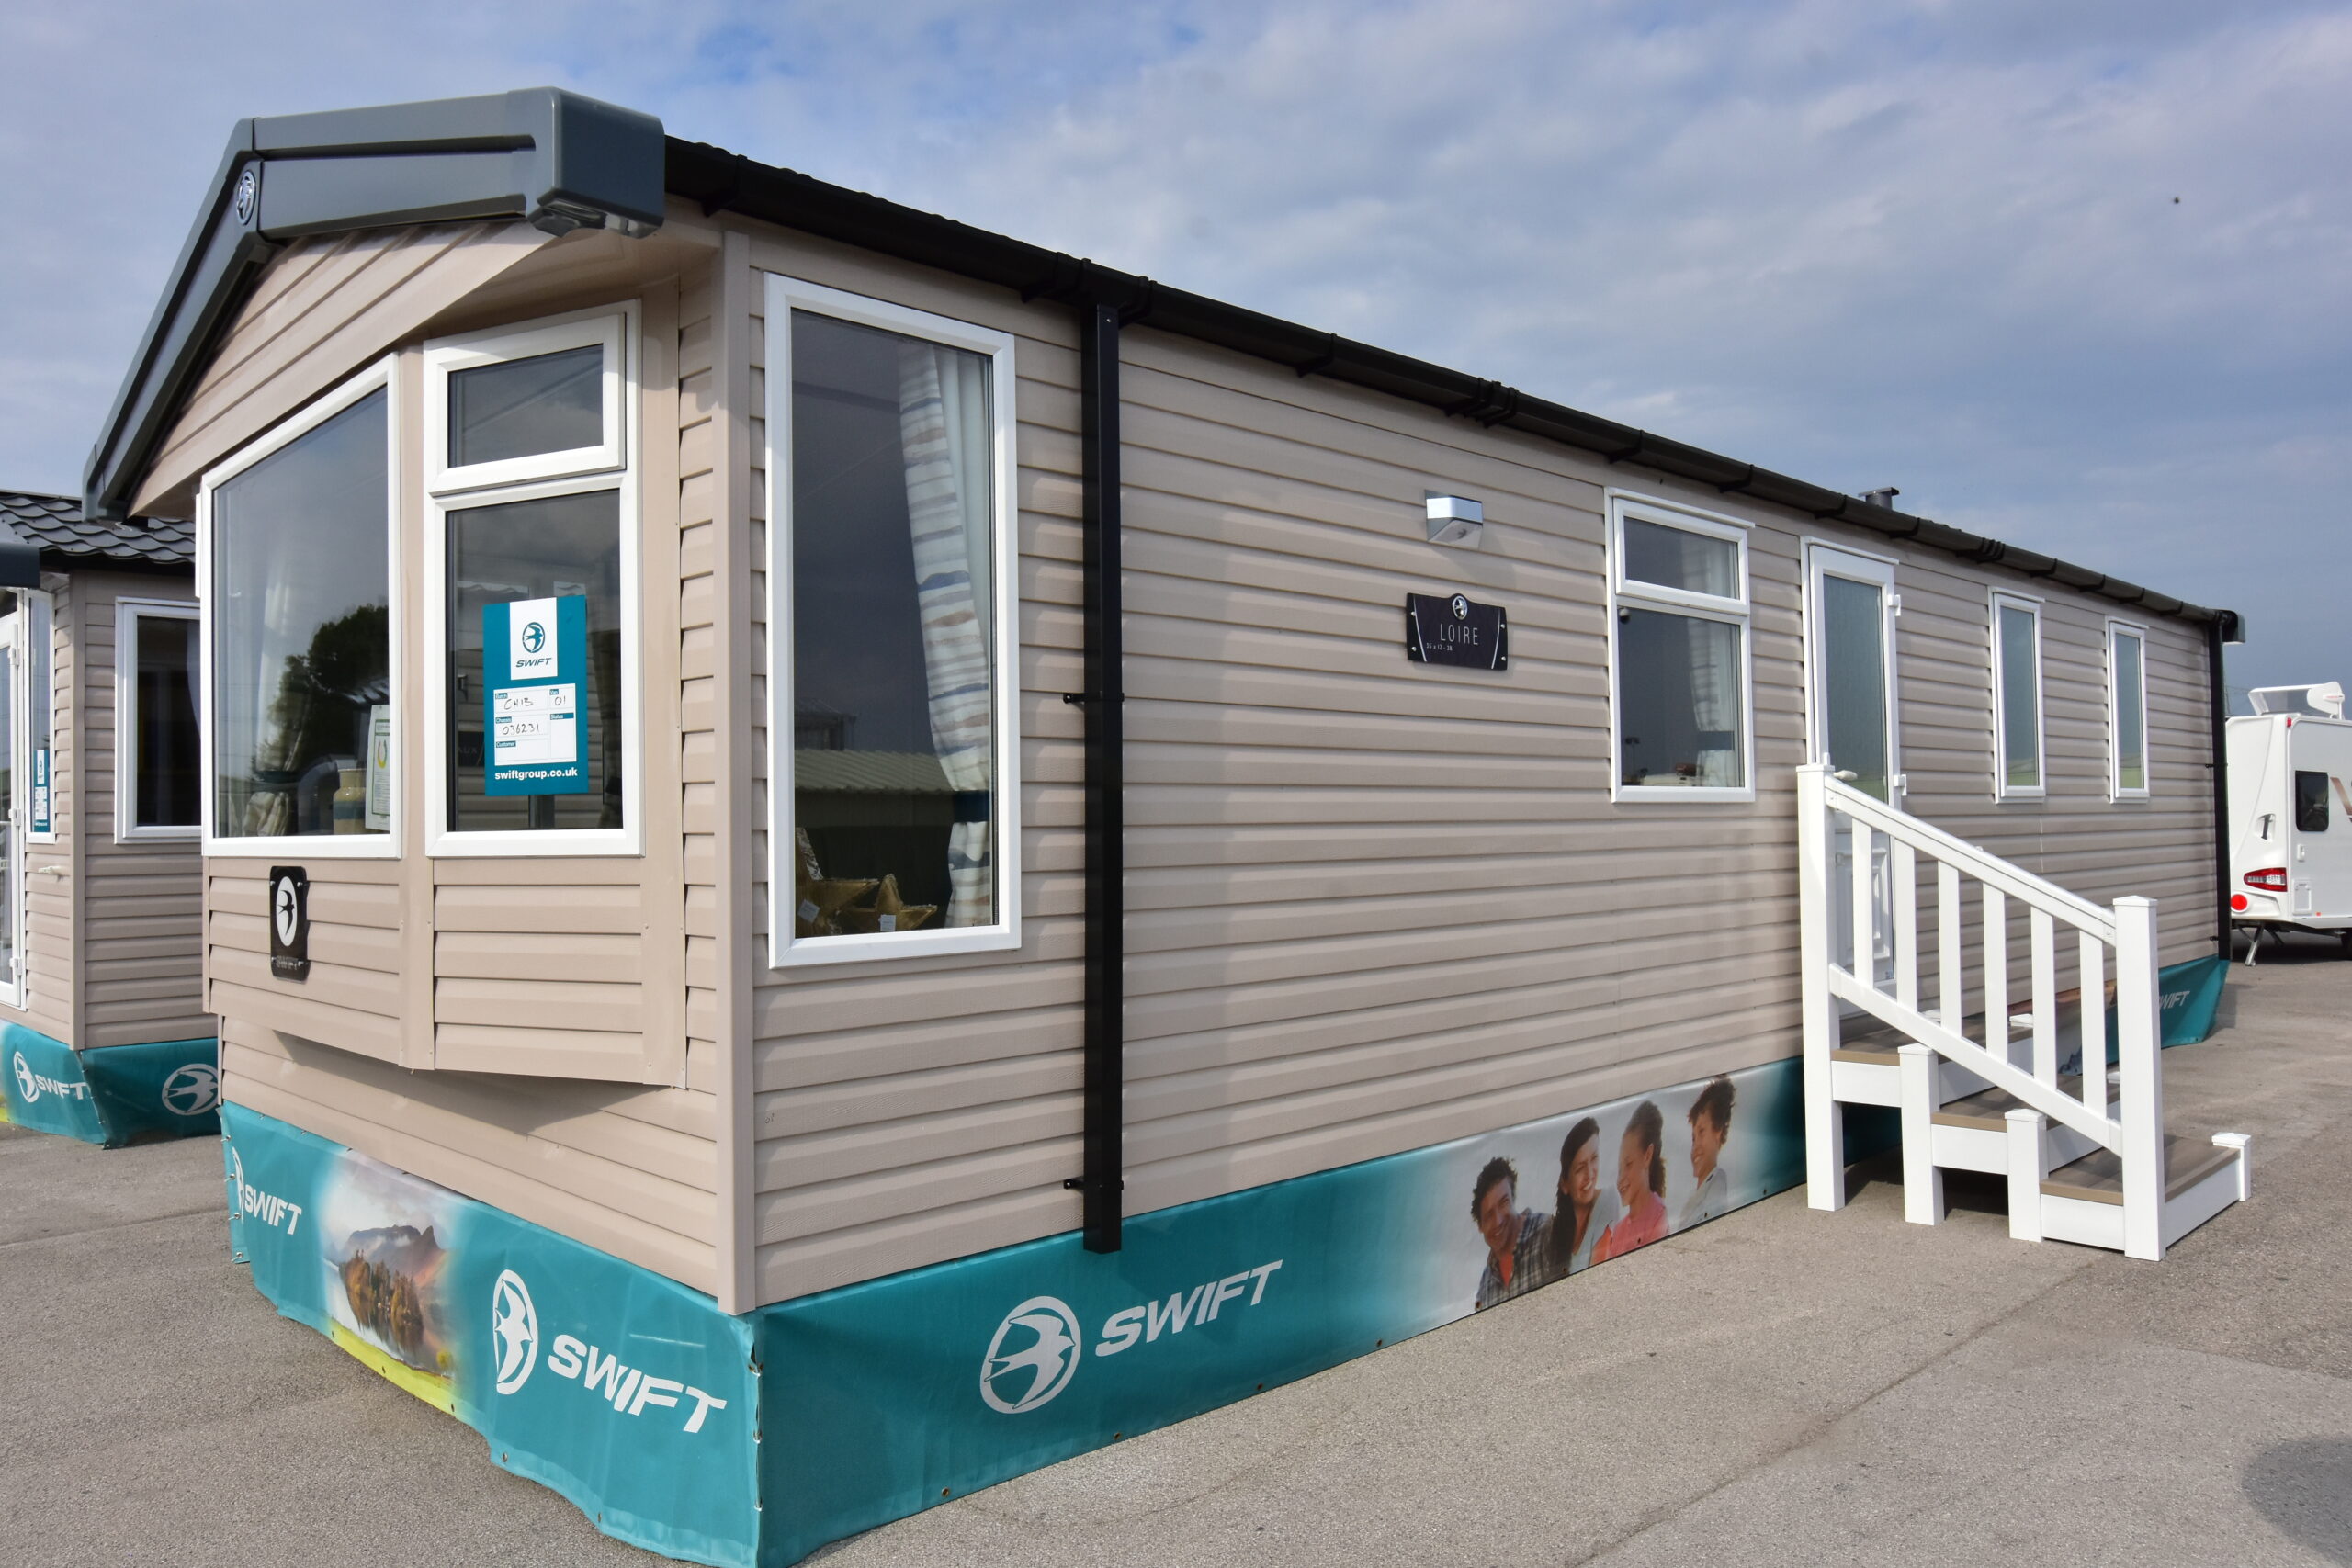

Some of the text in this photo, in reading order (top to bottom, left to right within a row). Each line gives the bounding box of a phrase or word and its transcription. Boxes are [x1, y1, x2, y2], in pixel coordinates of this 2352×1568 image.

[1440, 623, 1479, 646] LOIRE
[515, 658, 552, 668] SWIFT
[502, 722, 540, 736] 036231
[494, 767, 578, 781] swiftgroup.co.uk
[2159, 990, 2191, 1010] WIFT
[34, 1074, 87, 1100] SWFT
[244, 1183, 302, 1235] SWIFT
[1094, 1258, 1283, 1358] SWIFT
[548, 1334, 728, 1434] SWIFT
